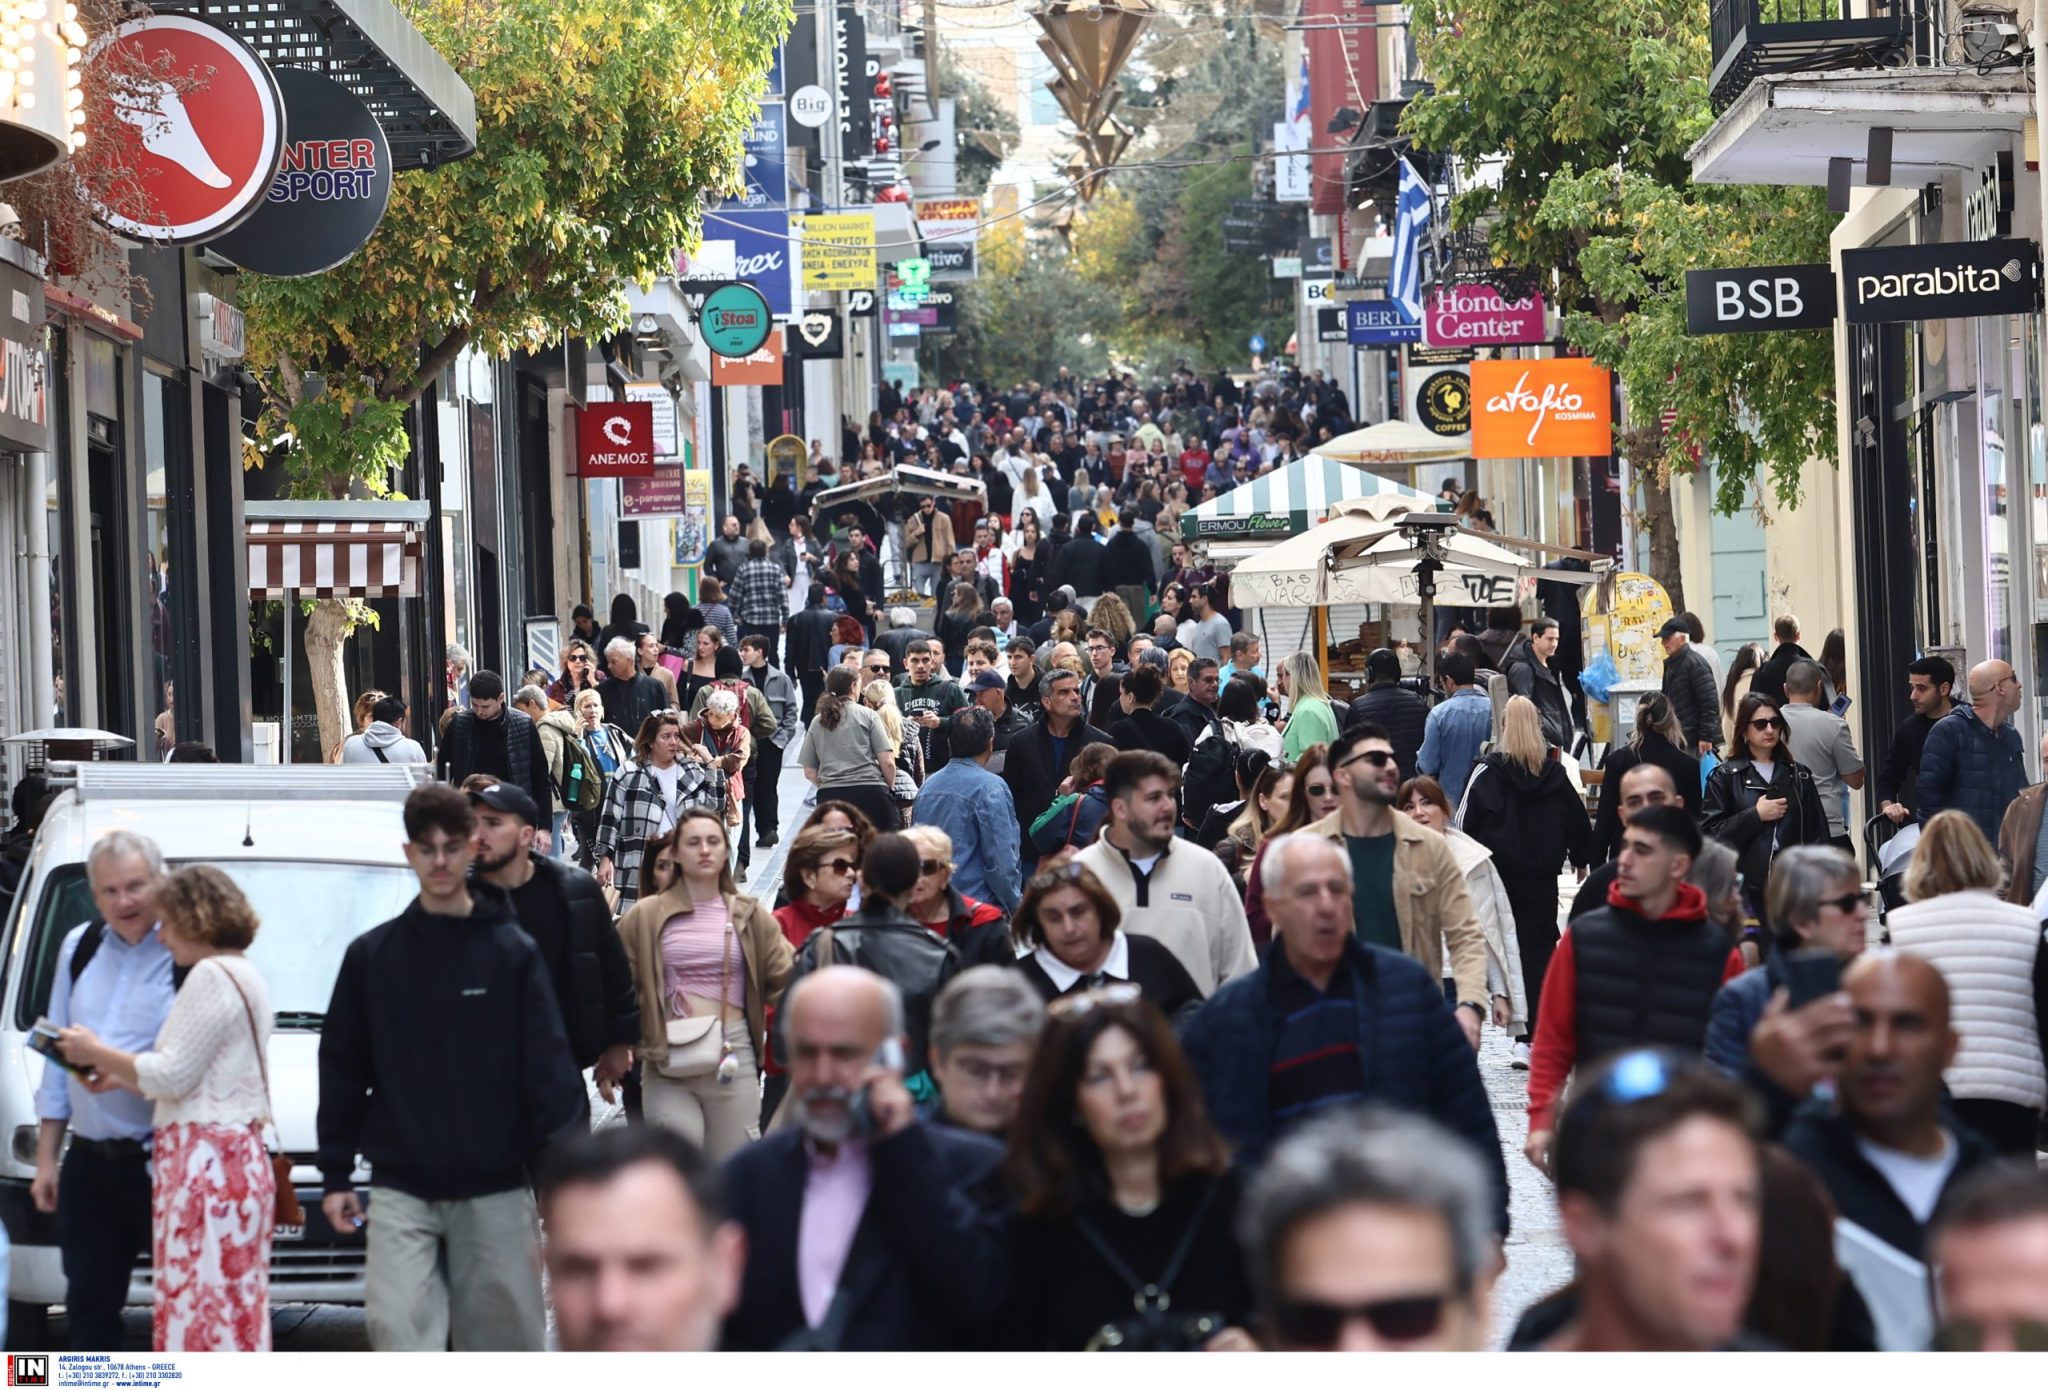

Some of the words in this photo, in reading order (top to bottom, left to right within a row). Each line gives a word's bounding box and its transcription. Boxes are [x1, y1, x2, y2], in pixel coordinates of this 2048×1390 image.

[837, 18, 850, 132] SEPHORA
[866, 60, 879, 76] D
[797, 98, 825, 112] Big
[266, 170, 374, 202] SPORT
[922, 200, 971, 212] ΑΓΟΡΑ
[736, 250, 784, 277] rex
[1858, 264, 2000, 305] parabita
[1436, 289, 1534, 314] Hondos
[1715, 277, 1804, 321] BSB
[1436, 313, 1525, 339] Center
[1554, 411, 1597, 422] KOSMIMA
[1435, 423, 1467, 432] COFFEE
[588, 452, 649, 466] ΑΝΕΜΟΣ
[1199, 520, 1246, 532] ERMOU
[1247, 514, 1289, 530] Flower
[904, 697, 937, 712] EMERSON
